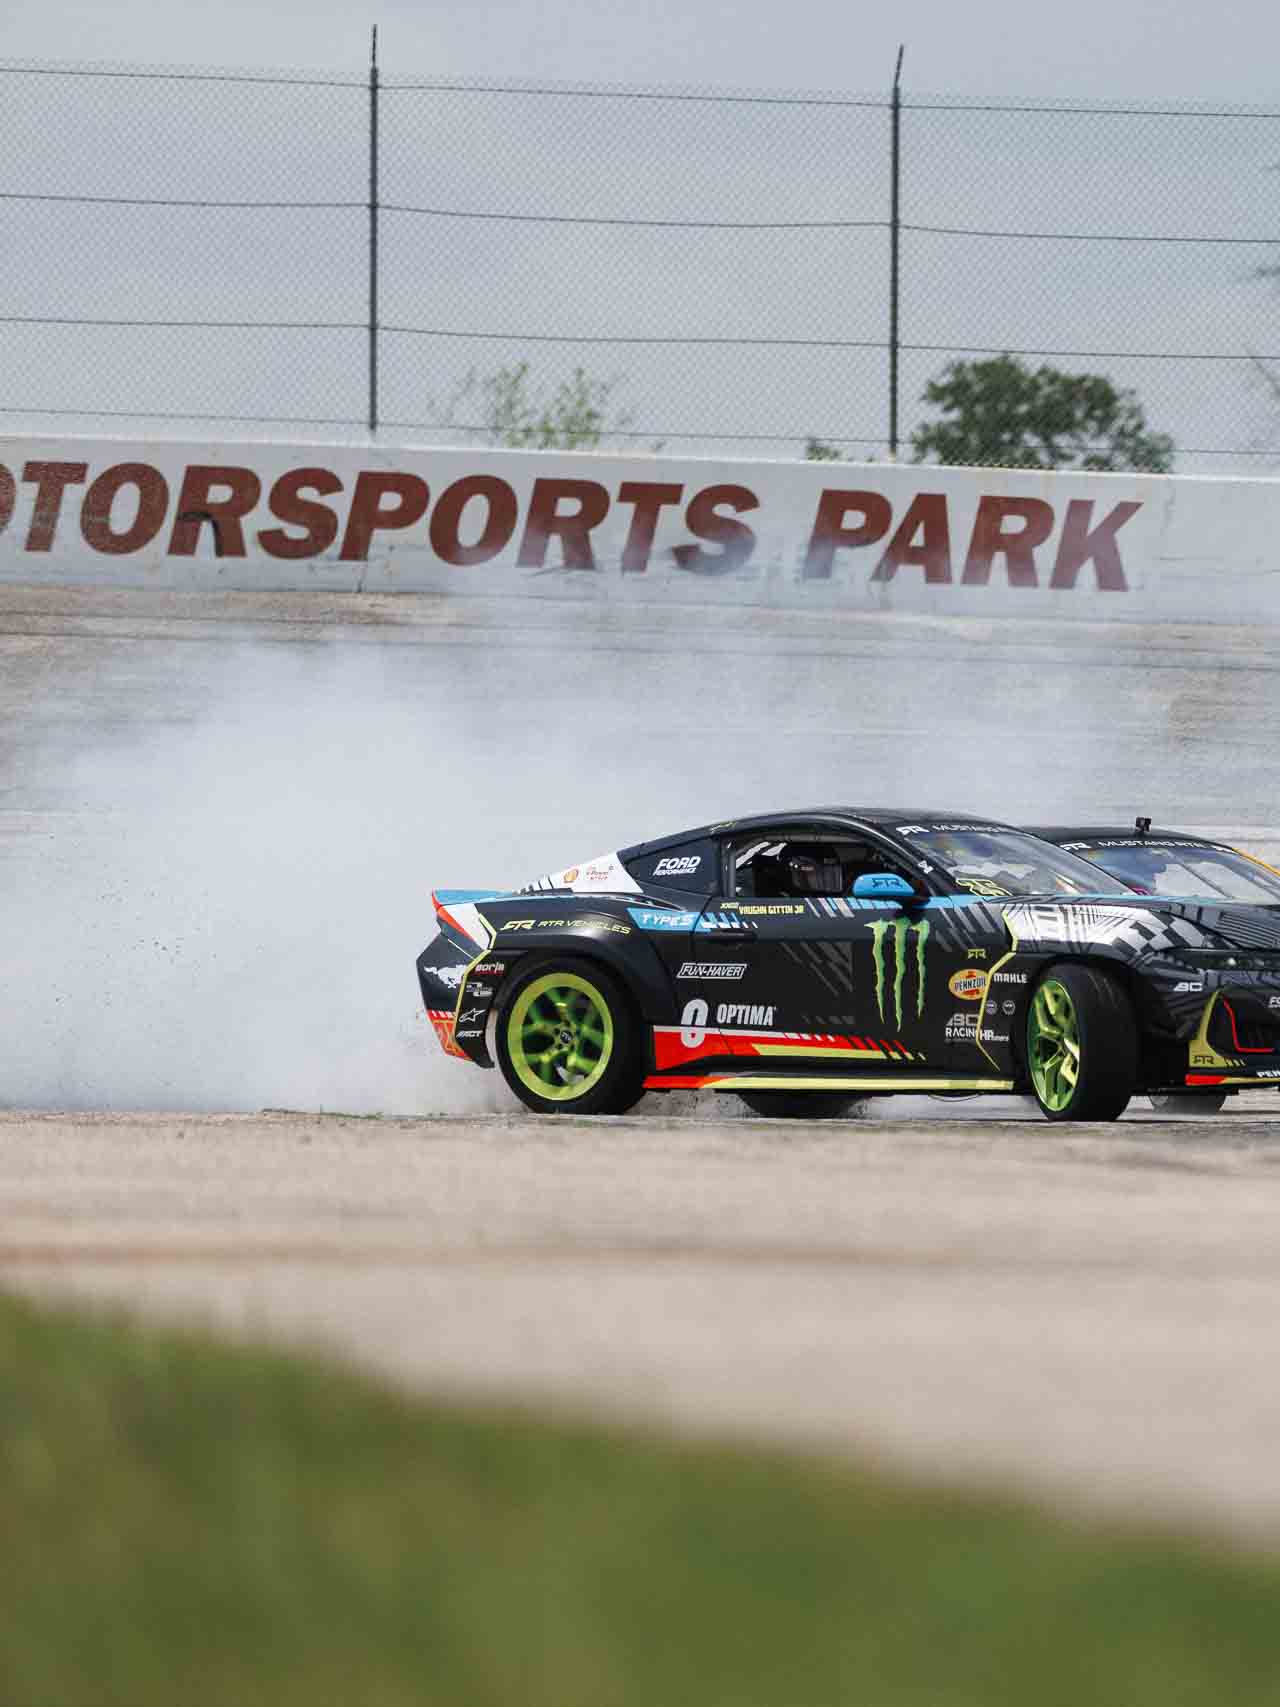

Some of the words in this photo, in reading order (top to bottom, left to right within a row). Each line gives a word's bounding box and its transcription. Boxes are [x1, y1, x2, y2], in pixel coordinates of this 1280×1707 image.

[800, 488, 1145, 592] PARK
[655, 856, 701, 871] FORD
[566, 920, 632, 935] VEHICLES
[681, 965, 740, 977] FUN-HAVER
[954, 978, 987, 992] PENNZOIL
[993, 973, 1028, 984] MAHLE
[716, 1004, 773, 1026] OPTIMA
[945, 1028, 981, 1037] RACIN
